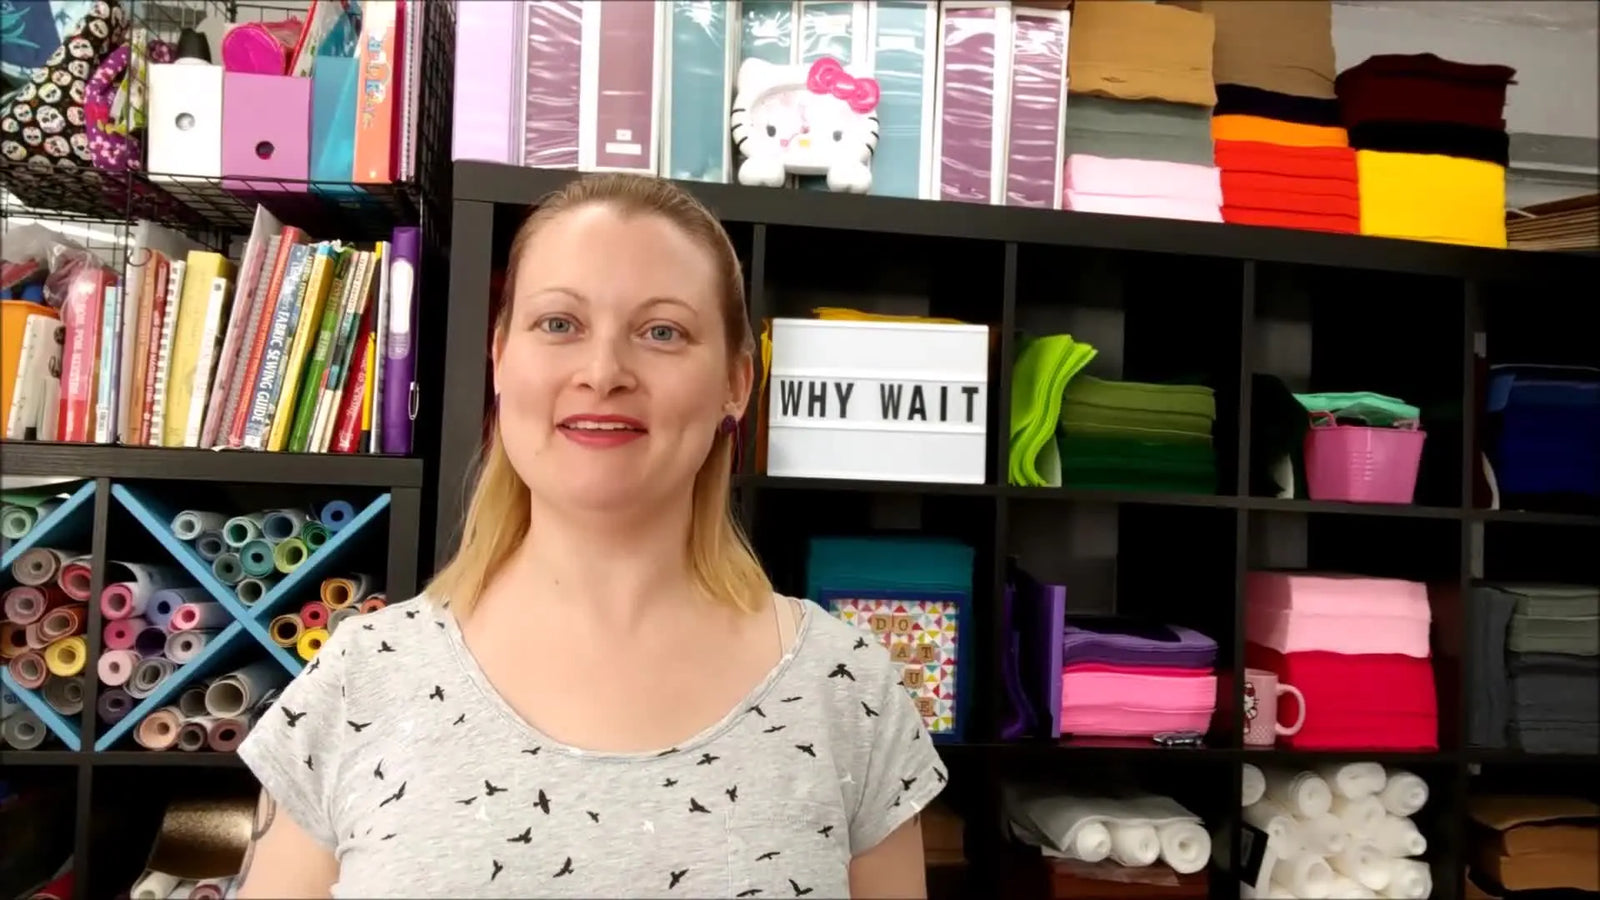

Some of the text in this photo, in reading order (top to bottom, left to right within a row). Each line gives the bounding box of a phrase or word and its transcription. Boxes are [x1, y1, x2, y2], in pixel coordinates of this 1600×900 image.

[270, 310, 291, 347] FABRIC
[259, 348, 282, 389] SEWING
[251, 390, 270, 423] GUIDE
[780, 380, 979, 422] WHY WAIT
[876, 619, 908, 630] DO
